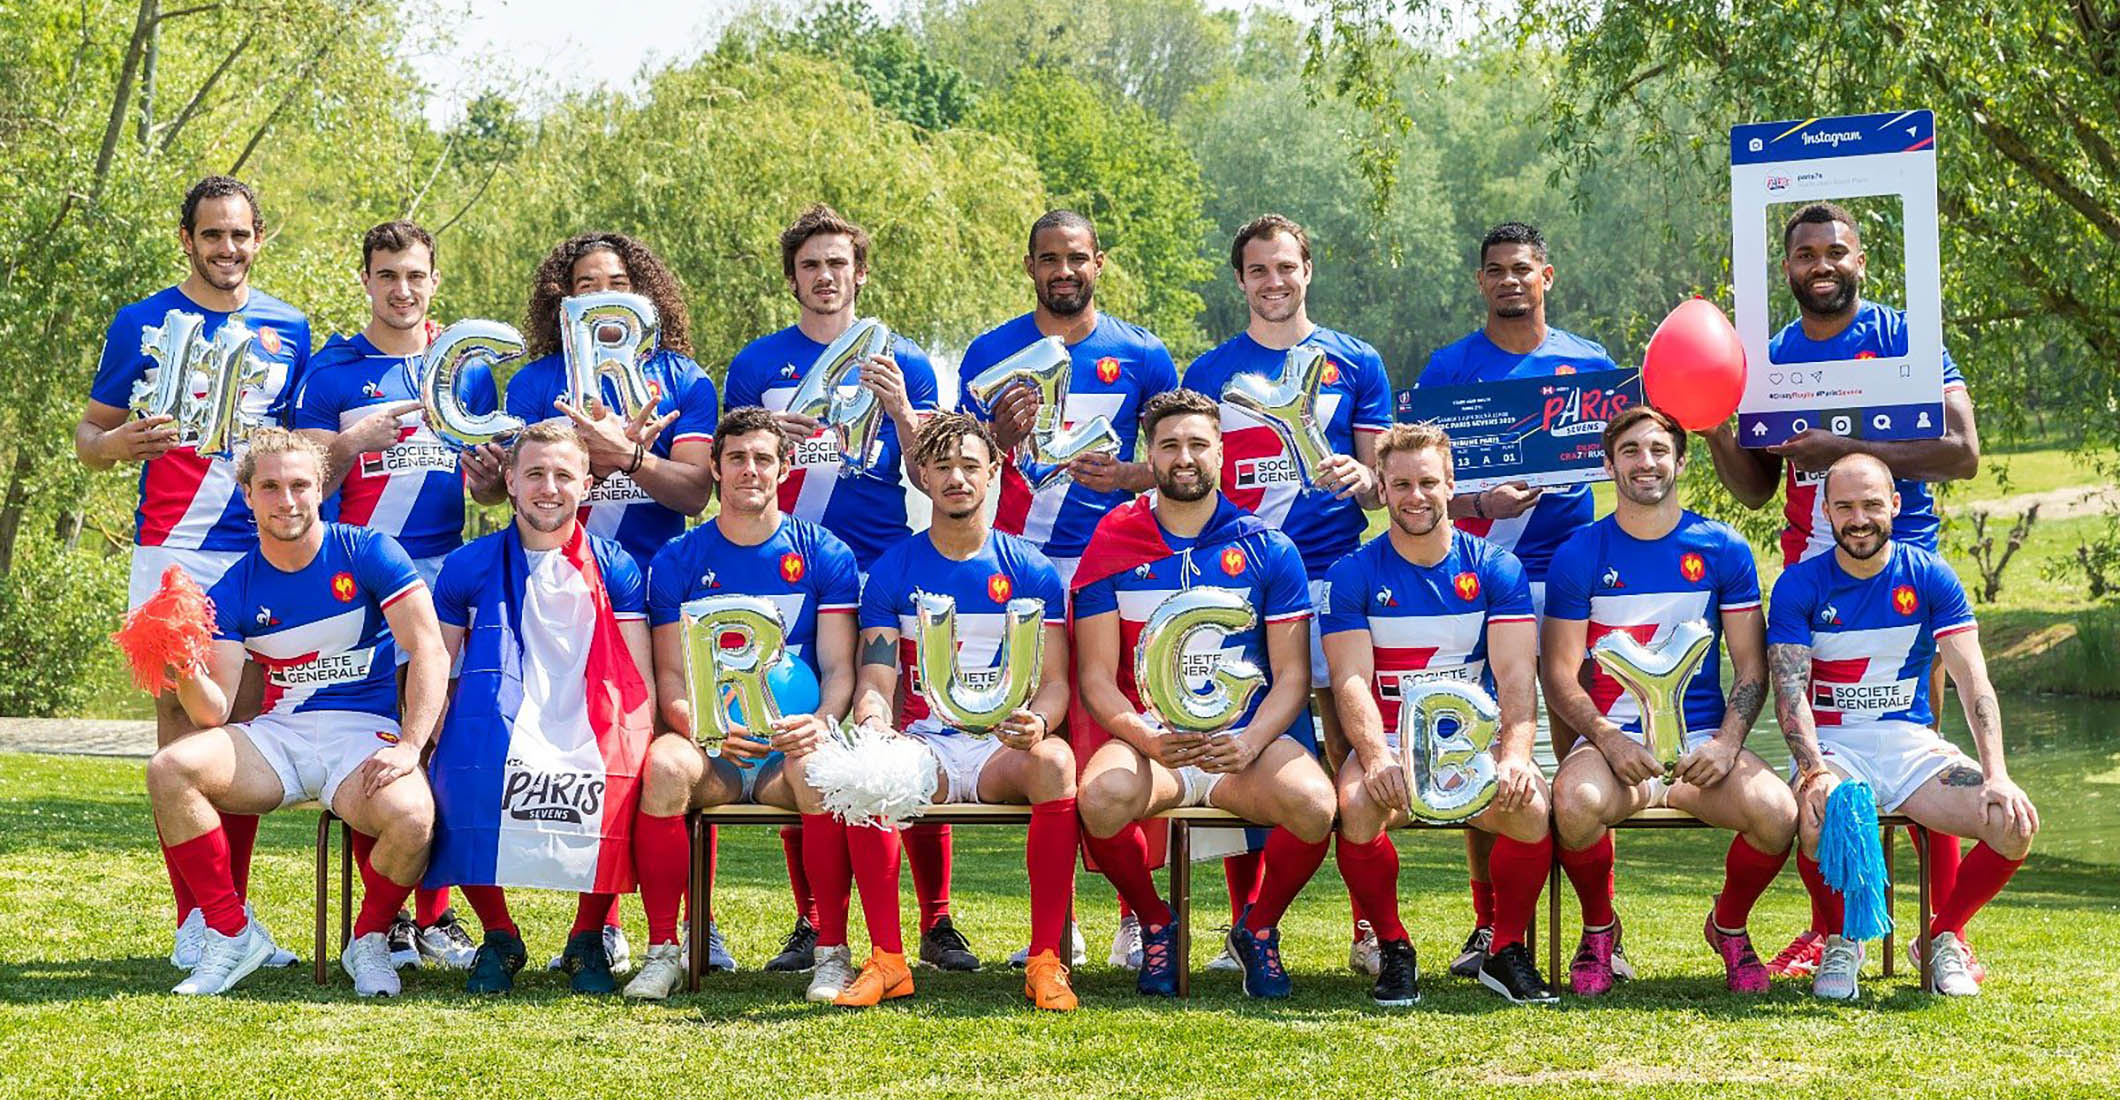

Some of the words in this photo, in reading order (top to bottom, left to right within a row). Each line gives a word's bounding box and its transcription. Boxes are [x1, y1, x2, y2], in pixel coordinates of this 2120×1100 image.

[1801, 130, 1862, 147] Instagram
[1450, 421, 1471, 429] PARIS
[1472, 419, 1498, 428] SEVENS
[1566, 422, 1599, 434] SEVENS
[1480, 437, 1499, 445] PARIS
[386, 446, 445, 458] SOCIETE
[1503, 453, 1516, 462] 01
[798, 453, 839, 465] GENE
[1458, 457, 1470, 466] 13
[1483, 456, 1490, 464] A
[587, 488, 650, 501] ENERAL
[288, 665, 367, 683] GENERALE
[1835, 685, 1900, 698] SOCIETE
[1836, 695, 1911, 709] GENERALE
[529, 808, 570, 820] SEVENS
